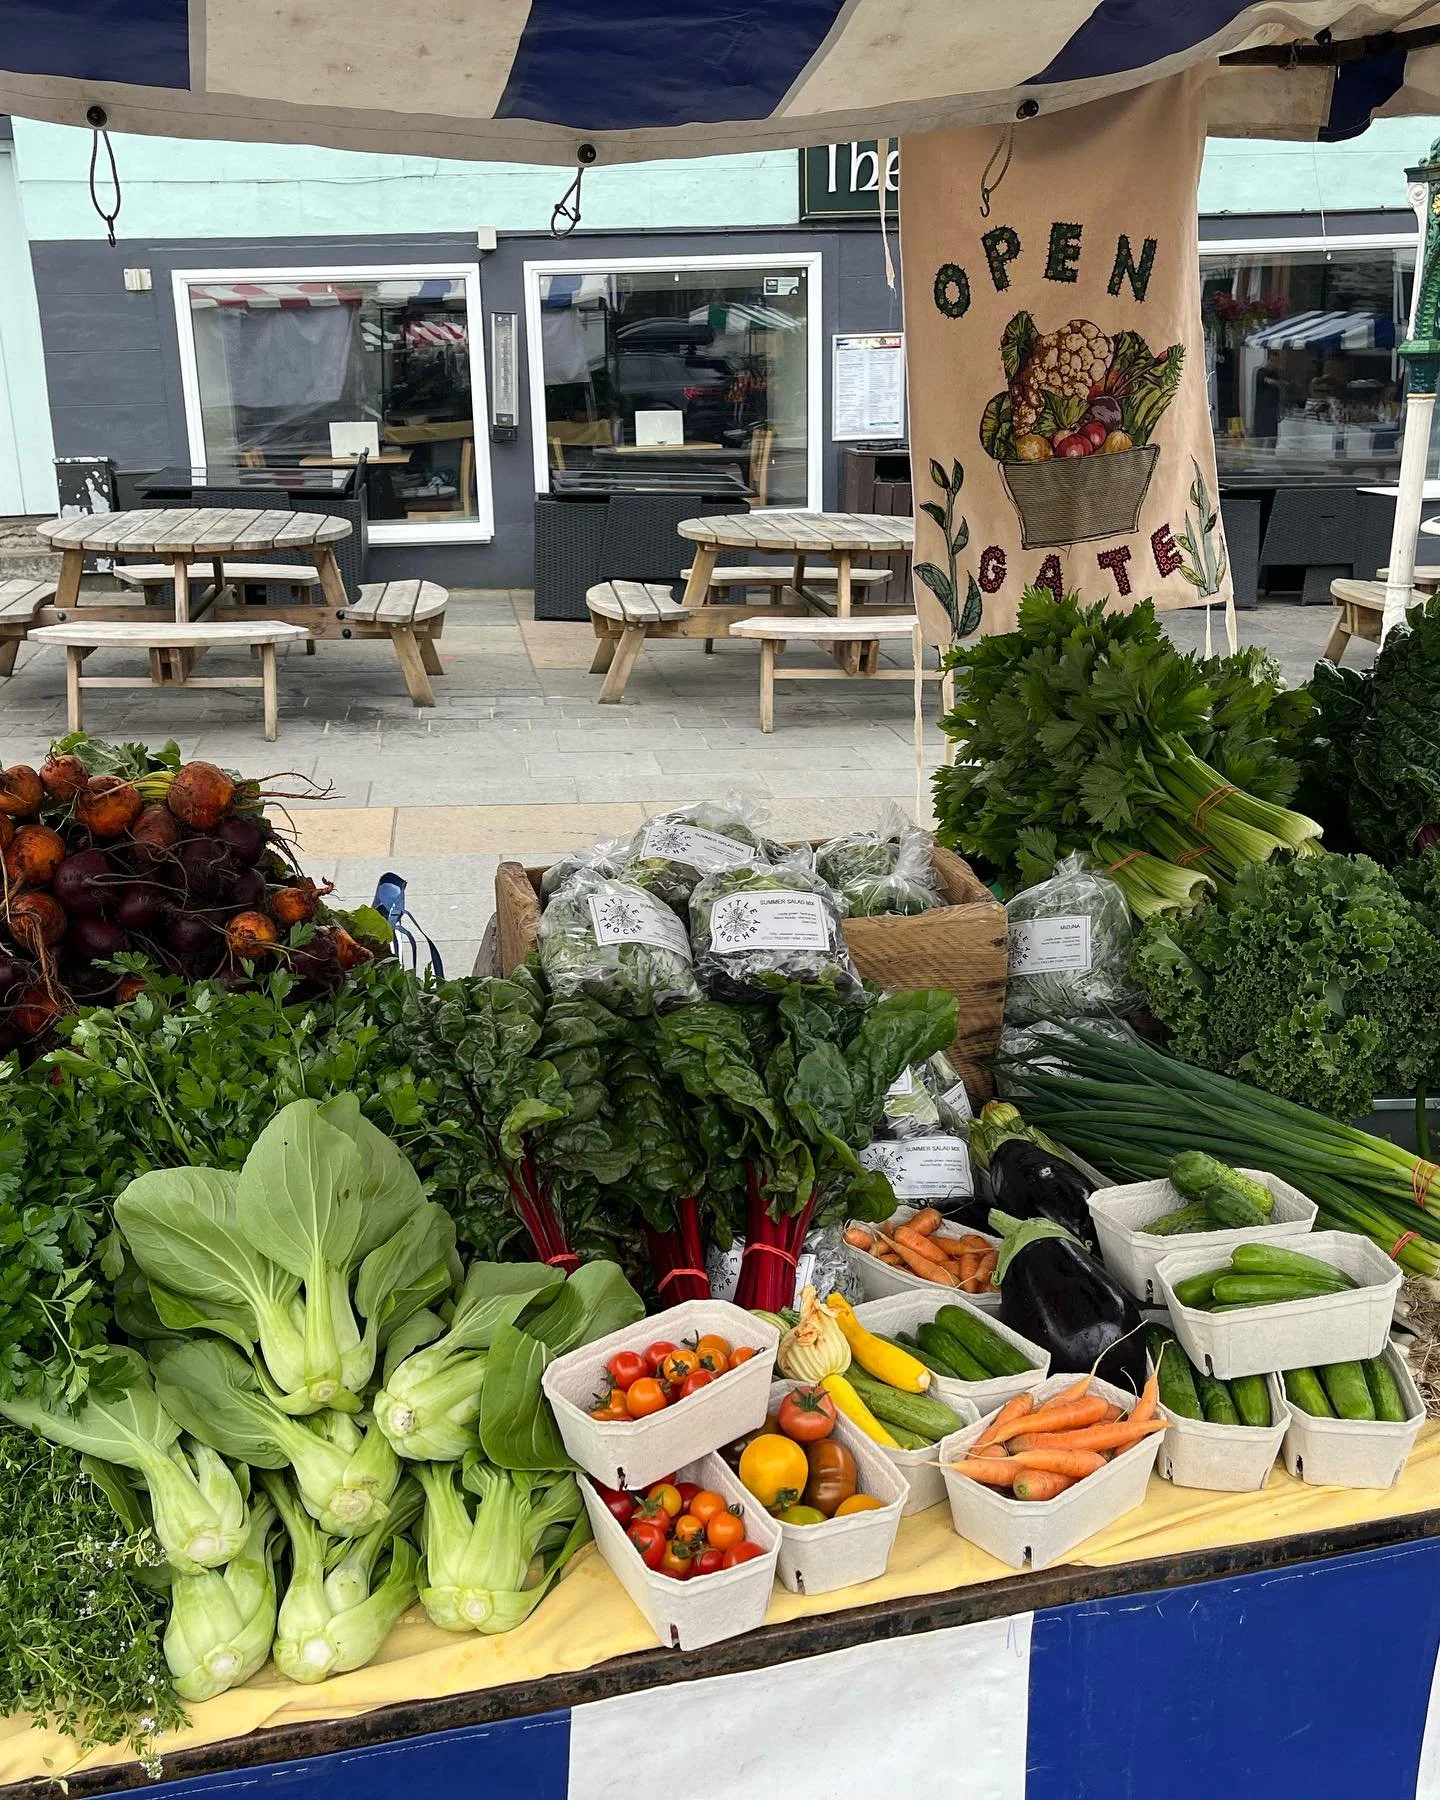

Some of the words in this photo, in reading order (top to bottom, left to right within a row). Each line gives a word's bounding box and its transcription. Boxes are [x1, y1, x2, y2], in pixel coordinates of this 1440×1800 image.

[933, 221, 1158, 320] OPEN
[978, 522, 1185, 603] GATE
[652, 828, 692, 840] LITTLE
[600, 898, 640, 915] LITTLE
[718, 899, 758, 919] LITTLE
[600, 917, 644, 935] TROCHRY
[716, 919, 761, 942] TROCHRY
[1008, 929, 1029, 942] TTLE
[862, 1147, 904, 1165] LITTLE
[711, 1270, 737, 1292] CHRY
